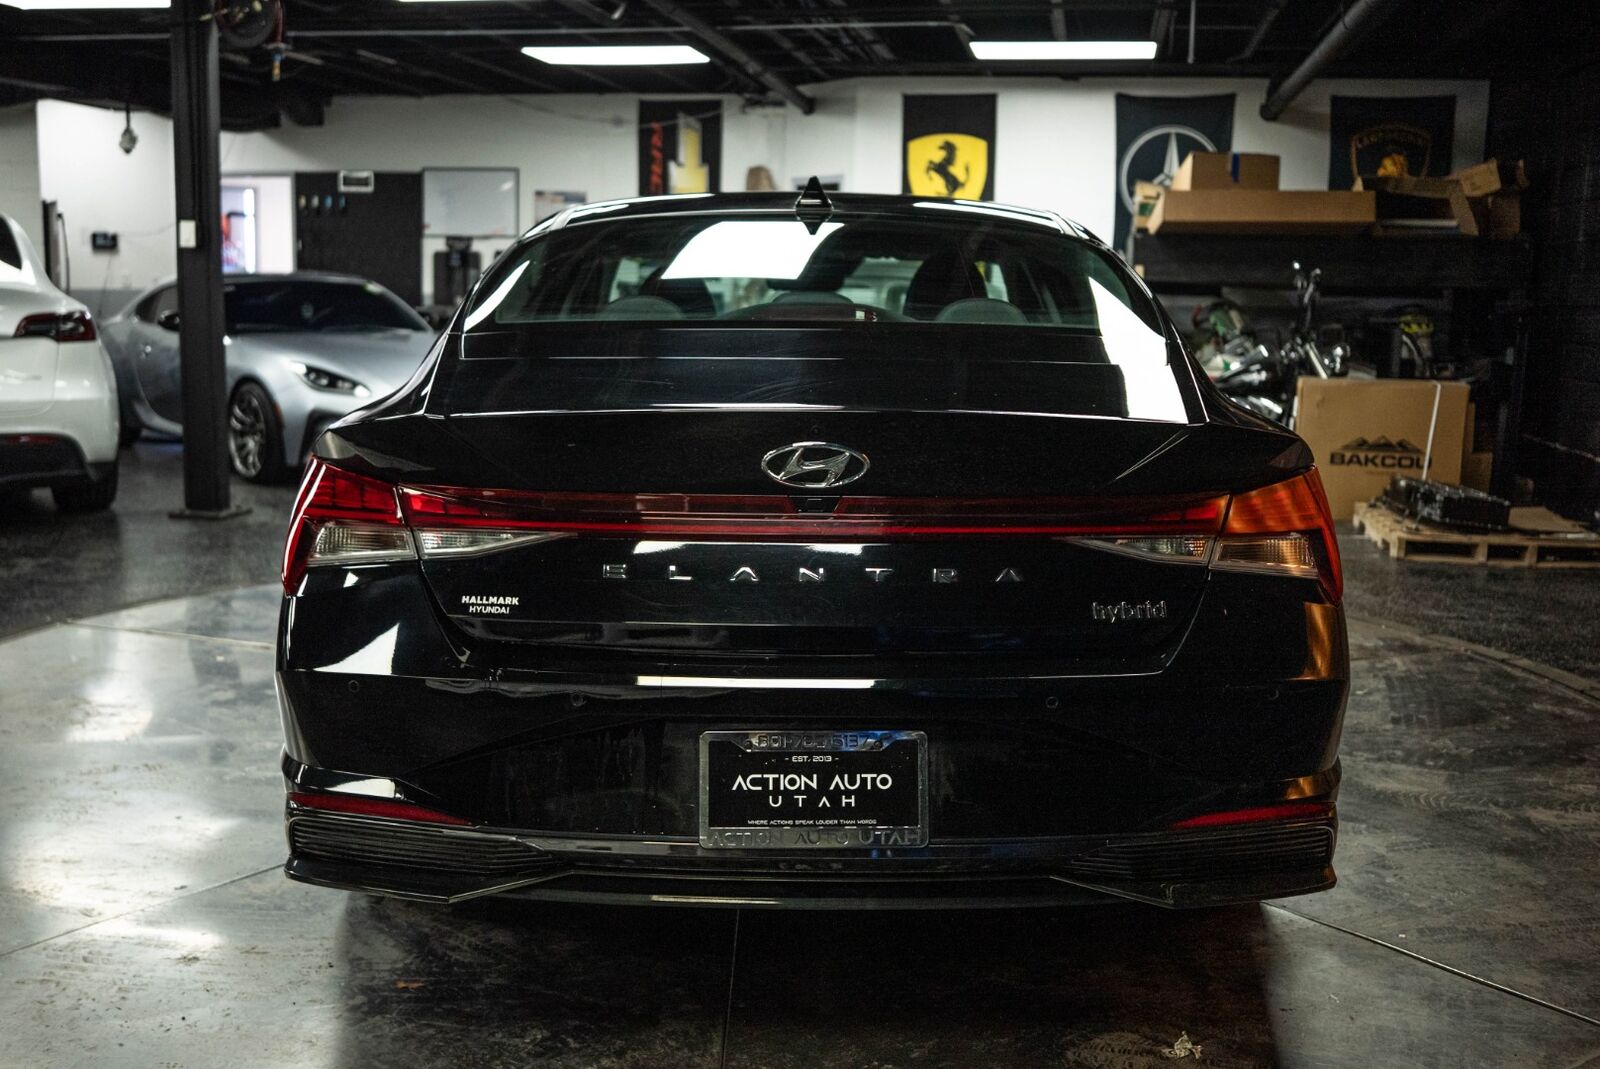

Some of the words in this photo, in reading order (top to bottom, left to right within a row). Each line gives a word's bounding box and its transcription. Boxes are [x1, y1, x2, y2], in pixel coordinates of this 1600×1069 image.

[602, 564, 1024, 583] ELANTRA
[461, 595, 520, 606] HALLMARK
[468, 605, 510, 615] HYUNDAI
[1091, 600, 1168, 623] hybrid
[791, 755, 811, 763] EST.
[812, 755, 832, 763] 2013
[731, 773, 817, 791] ACTION
[829, 773, 893, 791] AUTO
[769, 795, 856, 808] UTAH
[858, 830, 921, 846] UTAH
